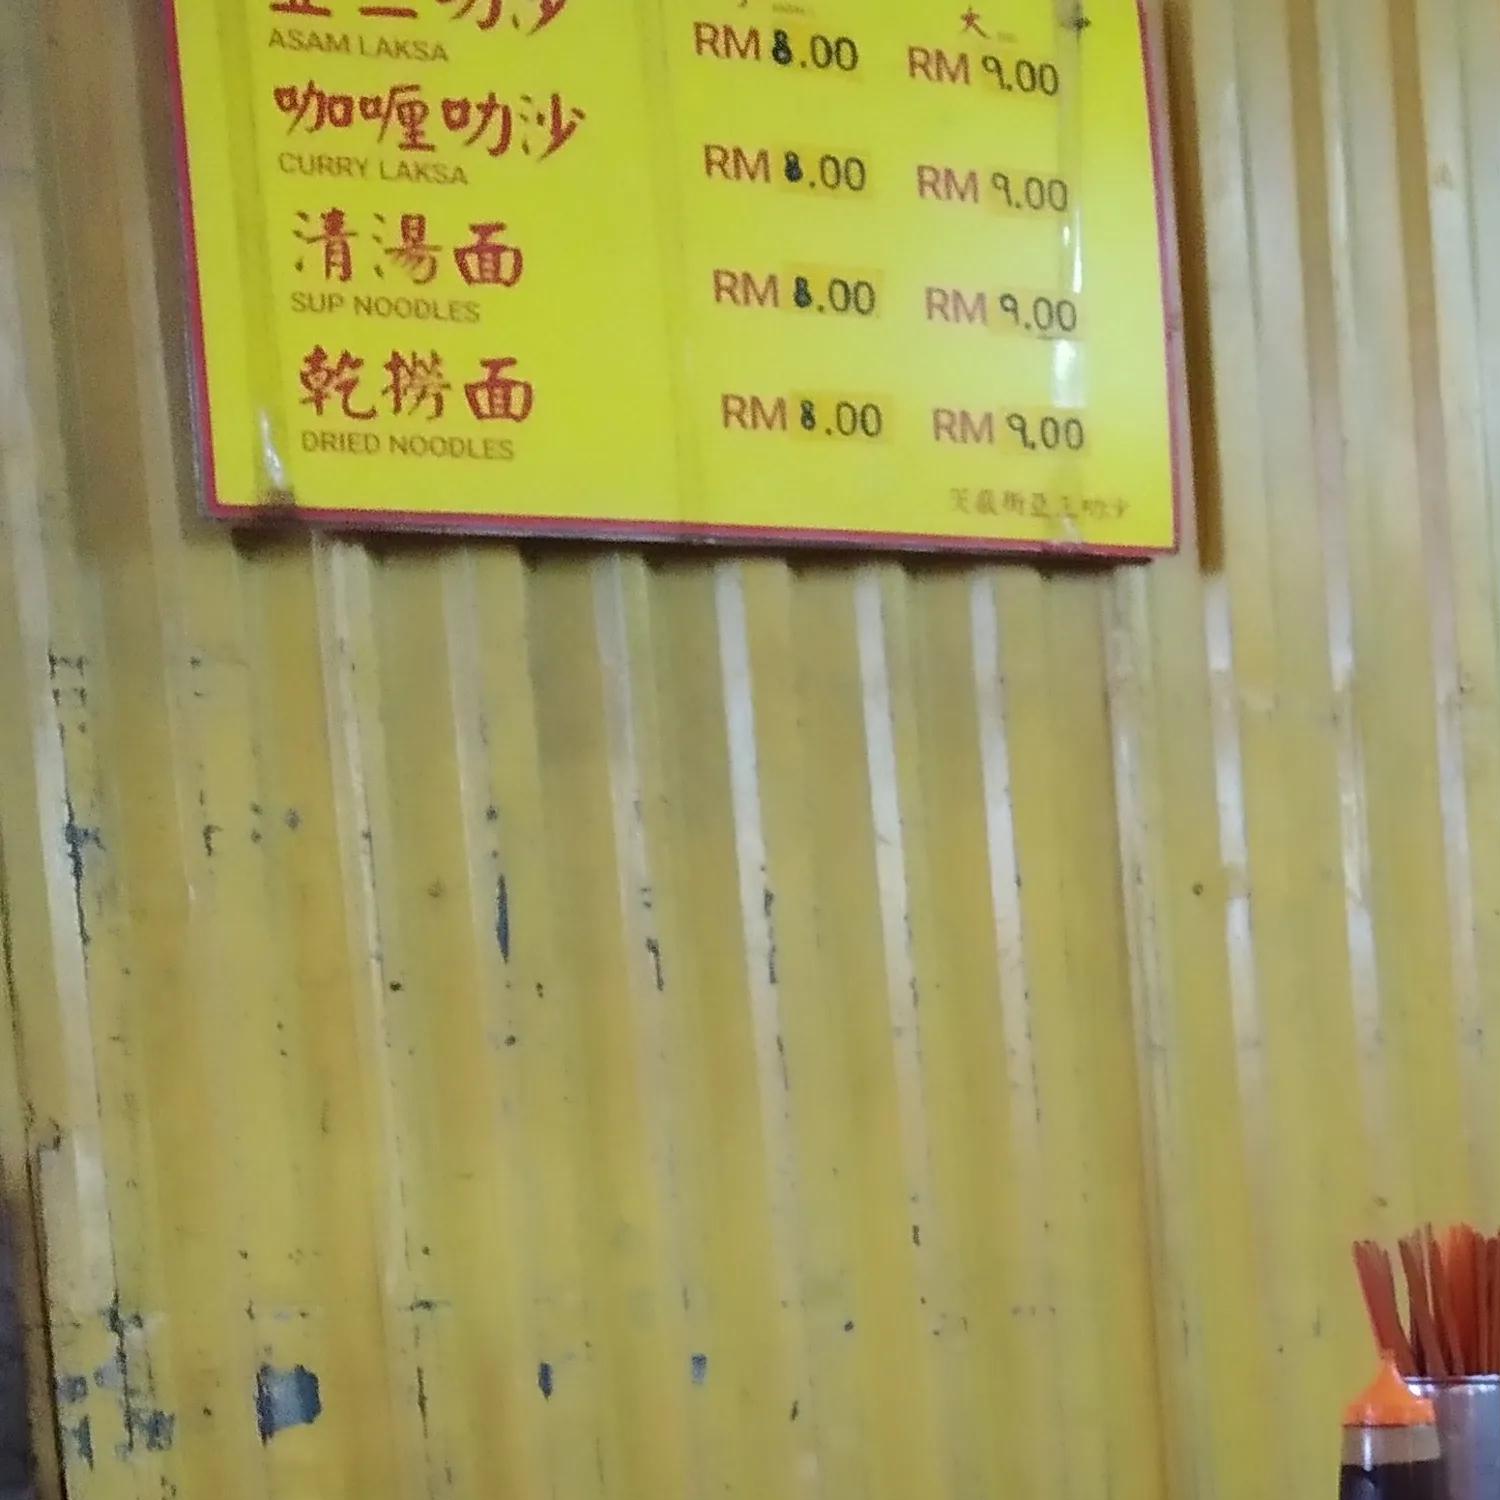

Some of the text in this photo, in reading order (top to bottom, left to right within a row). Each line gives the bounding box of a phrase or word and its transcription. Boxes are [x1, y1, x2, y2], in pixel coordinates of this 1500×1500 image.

[268, 28, 450, 62] ASAM LAKSA
[693, 21, 858, 71] RM 8.00
[908, 46, 1059, 96] RM 9.00
[273, 80, 586, 161] 咖喱叻沙
[278, 151, 469, 186] CURRY LAKSA
[704, 145, 866, 191] RM 8.00
[917, 164, 1069, 212] RM 9.00
[292, 207, 525, 288] 清湯面
[291, 291, 481, 324] SUP NOODLES
[713, 269, 877, 317] RM 8.00
[925, 286, 1078, 332] RM 9.00
[721, 394, 883, 439] RM 8.00
[932, 408, 1085, 450] RM 9.00
[302, 431, 515, 461] DRIED NOODLES
